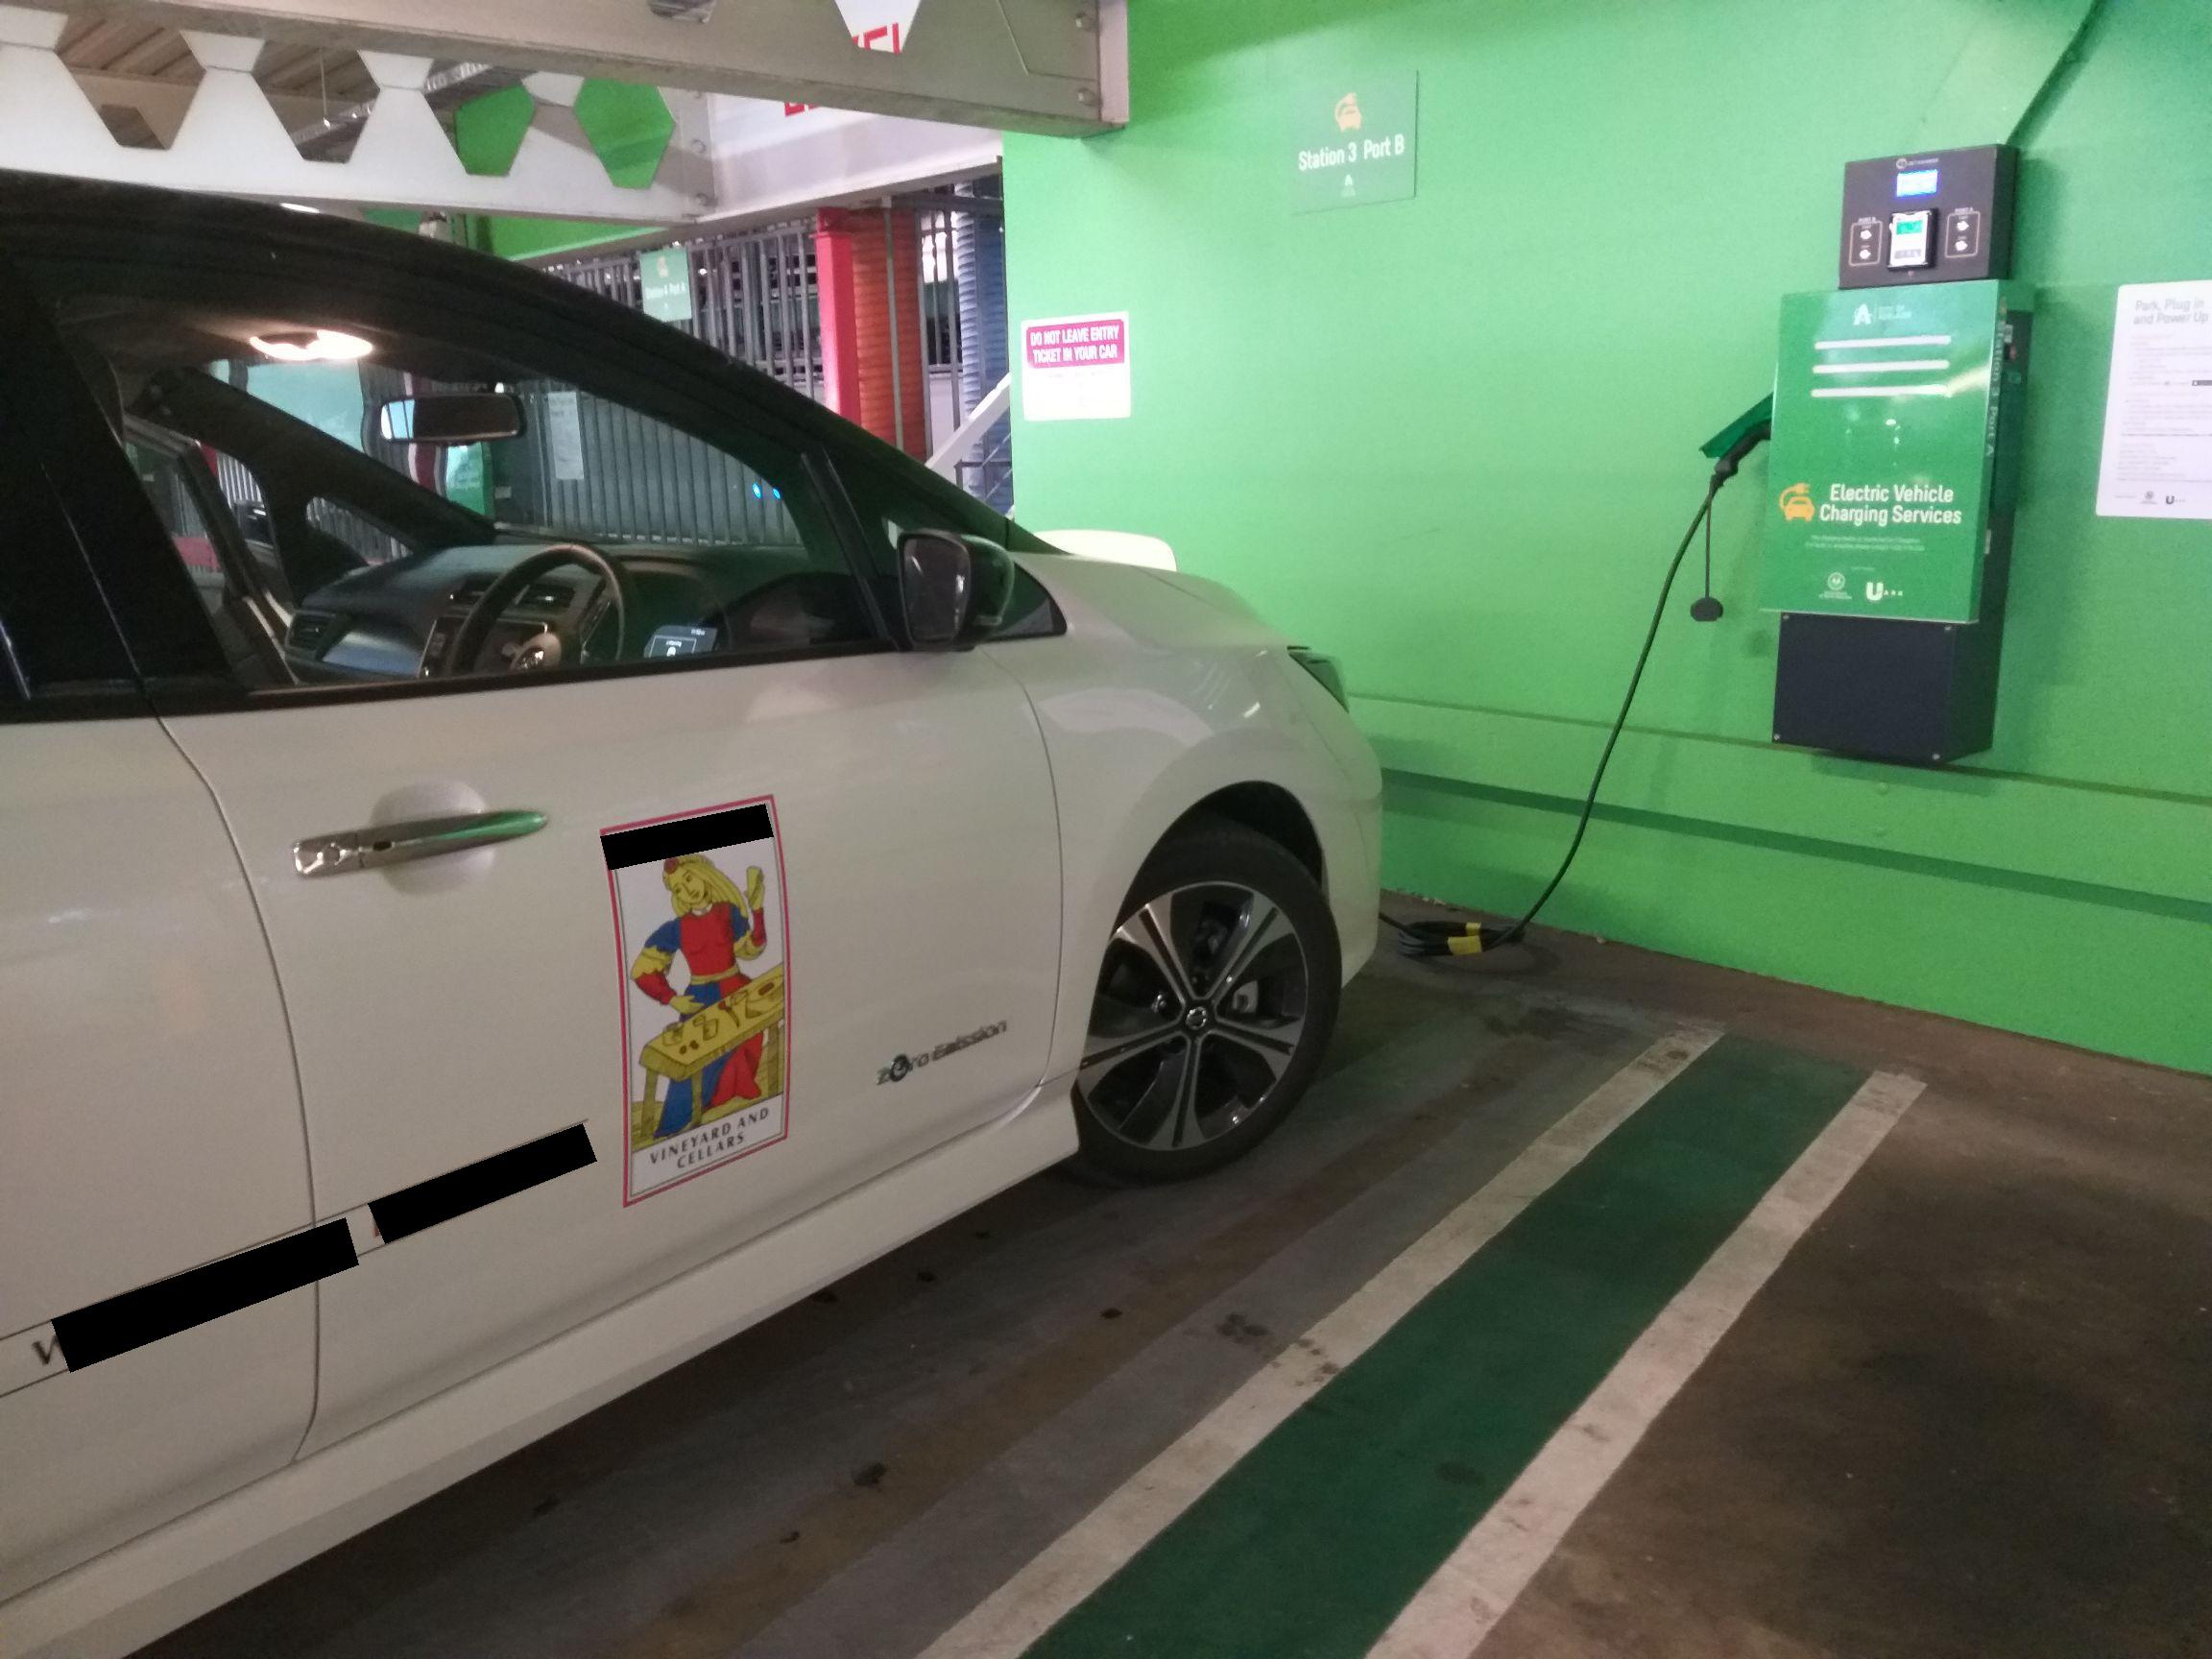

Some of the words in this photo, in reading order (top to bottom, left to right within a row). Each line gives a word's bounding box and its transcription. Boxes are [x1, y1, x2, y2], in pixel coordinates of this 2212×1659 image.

[1298, 146, 1345, 171] Station
[1348, 141, 1358, 162] 3
[1363, 136, 1391, 159] Port
[1394, 133, 1405, 156] B
[2133, 313, 2154, 325] and
[2156, 312, 2192, 325] Power
[2193, 310, 2209, 325] Up
[1030, 331, 1043, 347] DO
[1044, 329, 1061, 346] NOT
[1062, 326, 1090, 344] LEAVE
[1090, 325, 1119, 342] ENTRY
[1032, 347, 1062, 364] TICKET
[1062, 346, 1073, 362] IN
[1073, 345, 1098, 361] YOUR
[1098, 344, 1118, 359] CAR
[1830, 483, 1889, 502] Electric
[1893, 484, 1955, 503] Vehicle
[1819, 504, 1888, 527] Charging
[1891, 504, 1962, 525] Services
[649, 1122, 732, 1165] VINEYARD
[737, 1107, 769, 1128] AND
[677, 1131, 745, 1169] CELLARS
